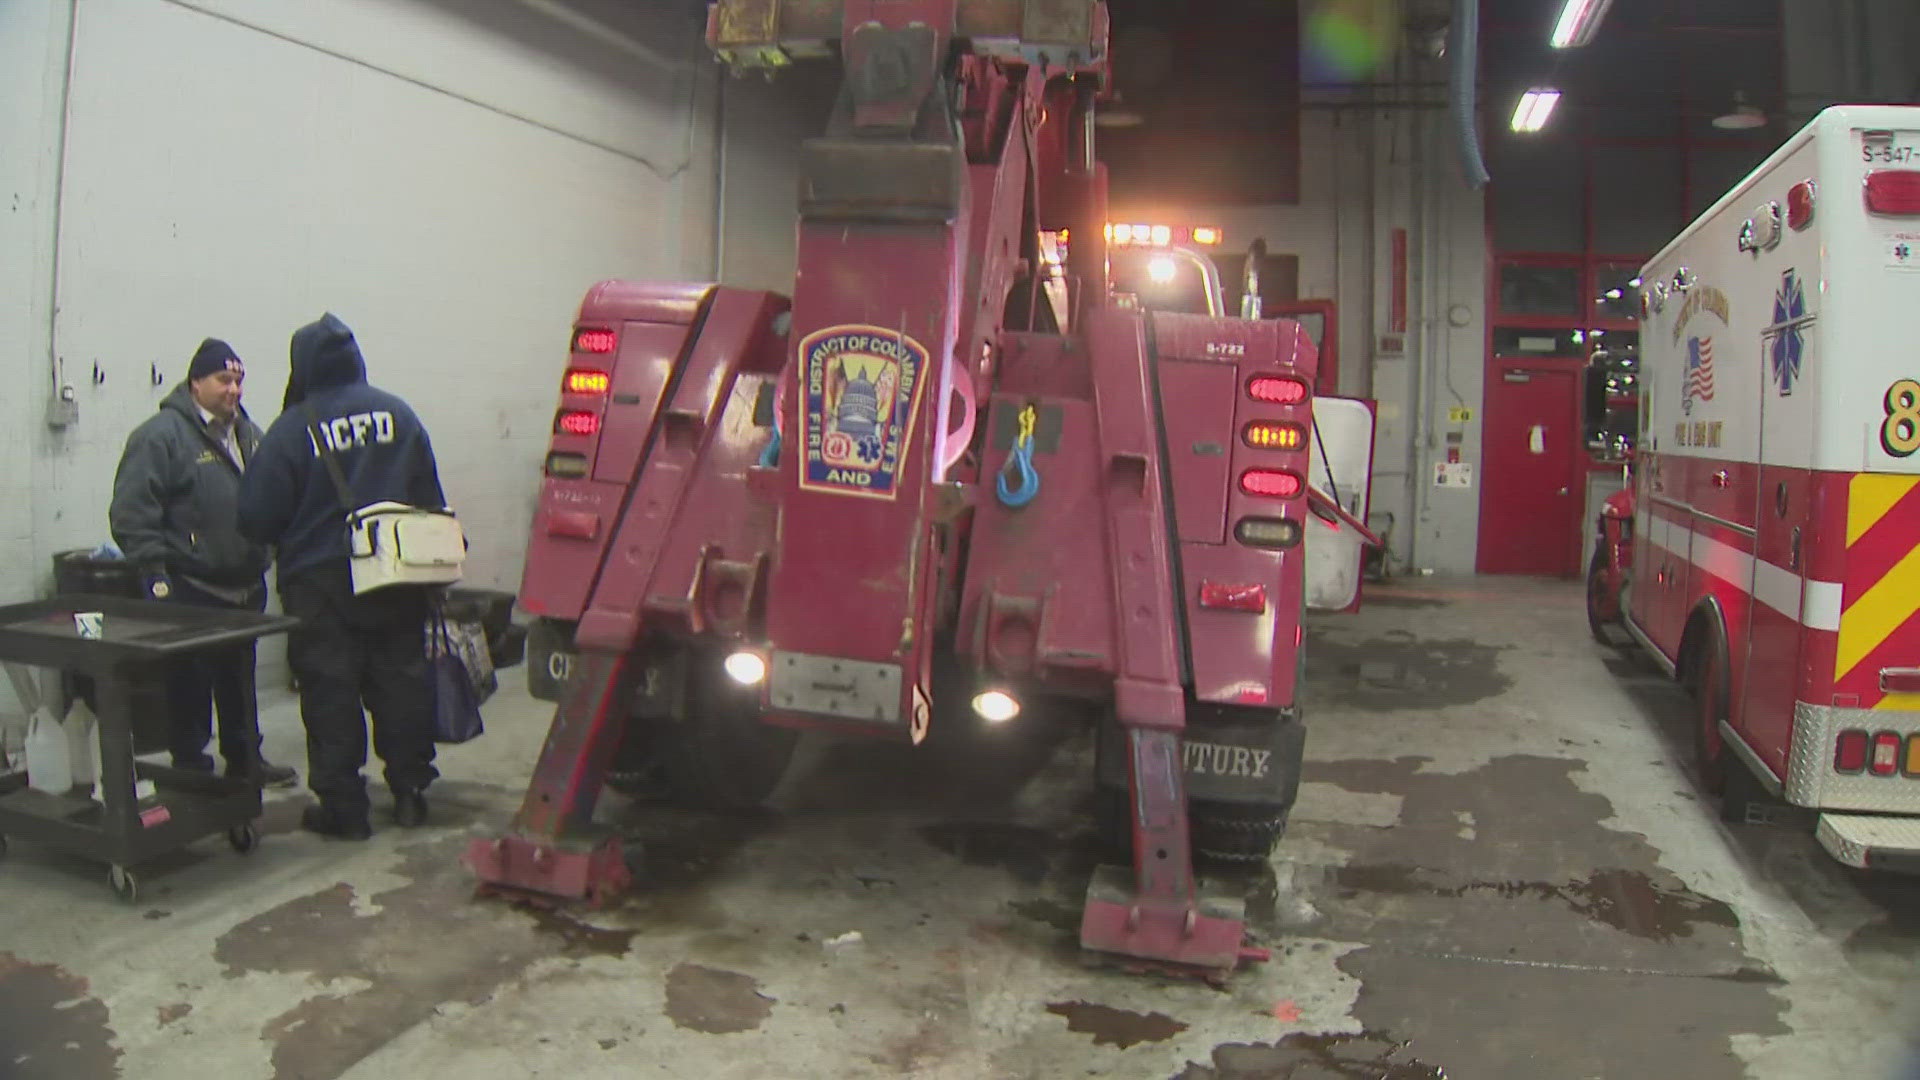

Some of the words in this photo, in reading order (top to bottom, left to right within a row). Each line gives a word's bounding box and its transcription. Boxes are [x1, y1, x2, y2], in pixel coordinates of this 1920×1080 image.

[809, 336, 847, 395] DISTRICT
[848, 335, 870, 351] OF
[808, 412, 822, 462] FIRE
[826, 468, 872, 486] AND
